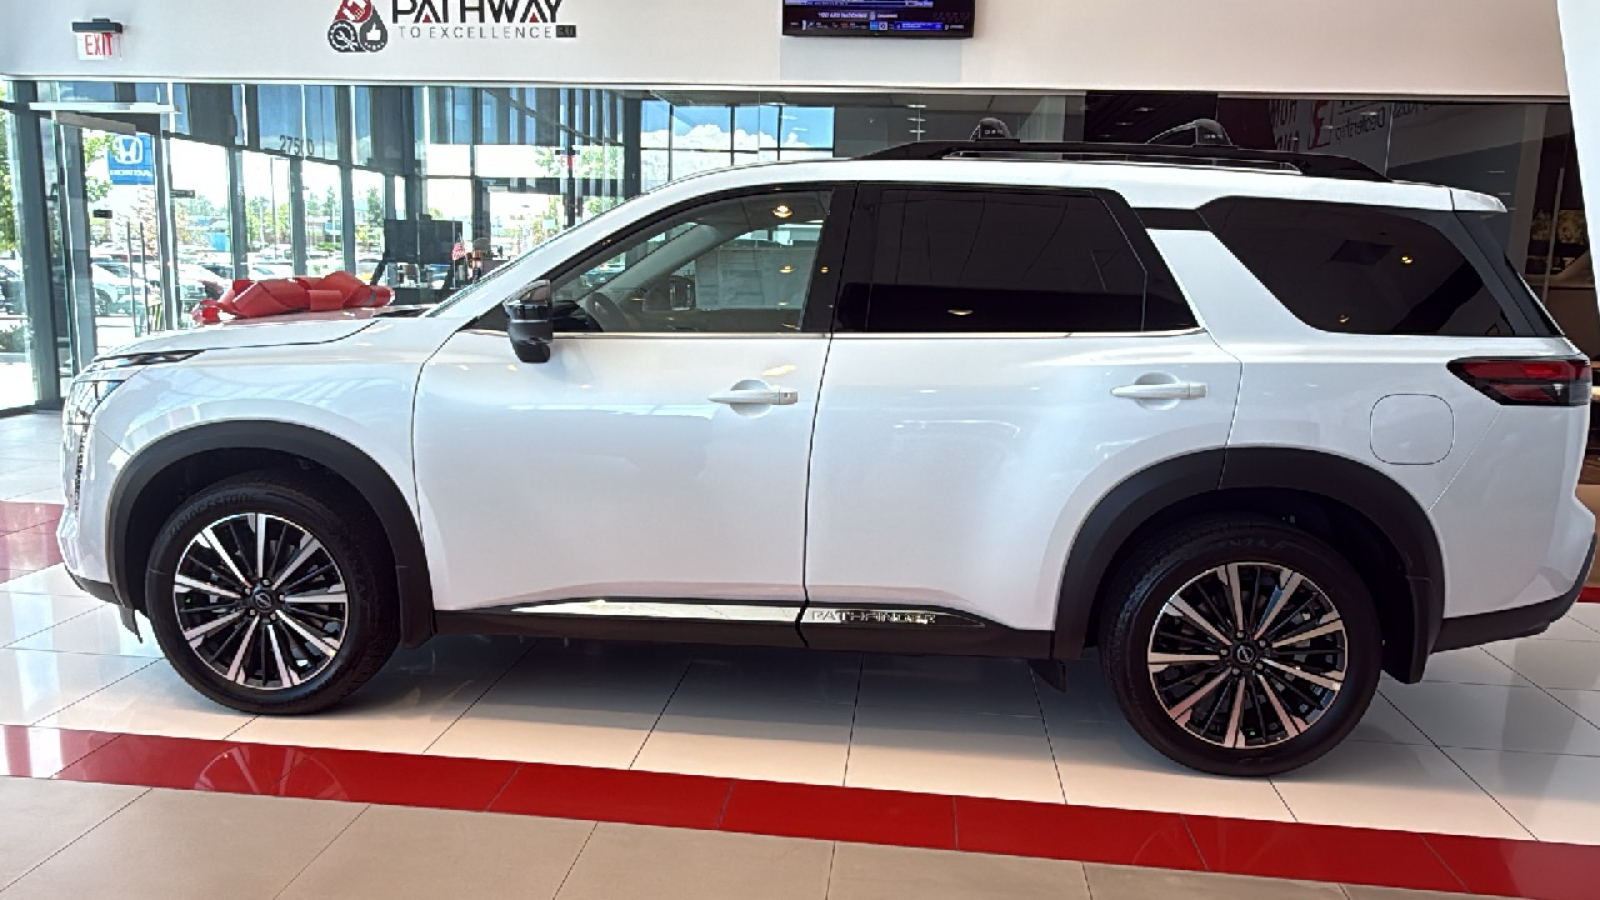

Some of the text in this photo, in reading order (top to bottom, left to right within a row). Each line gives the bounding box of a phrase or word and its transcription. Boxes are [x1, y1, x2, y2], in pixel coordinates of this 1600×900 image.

[392, 0, 562, 23] PATHWAY
[398, 25, 421, 38] TO
[429, 26, 552, 39] EXCELLENCE
[84, 33, 113, 56] EXIT
